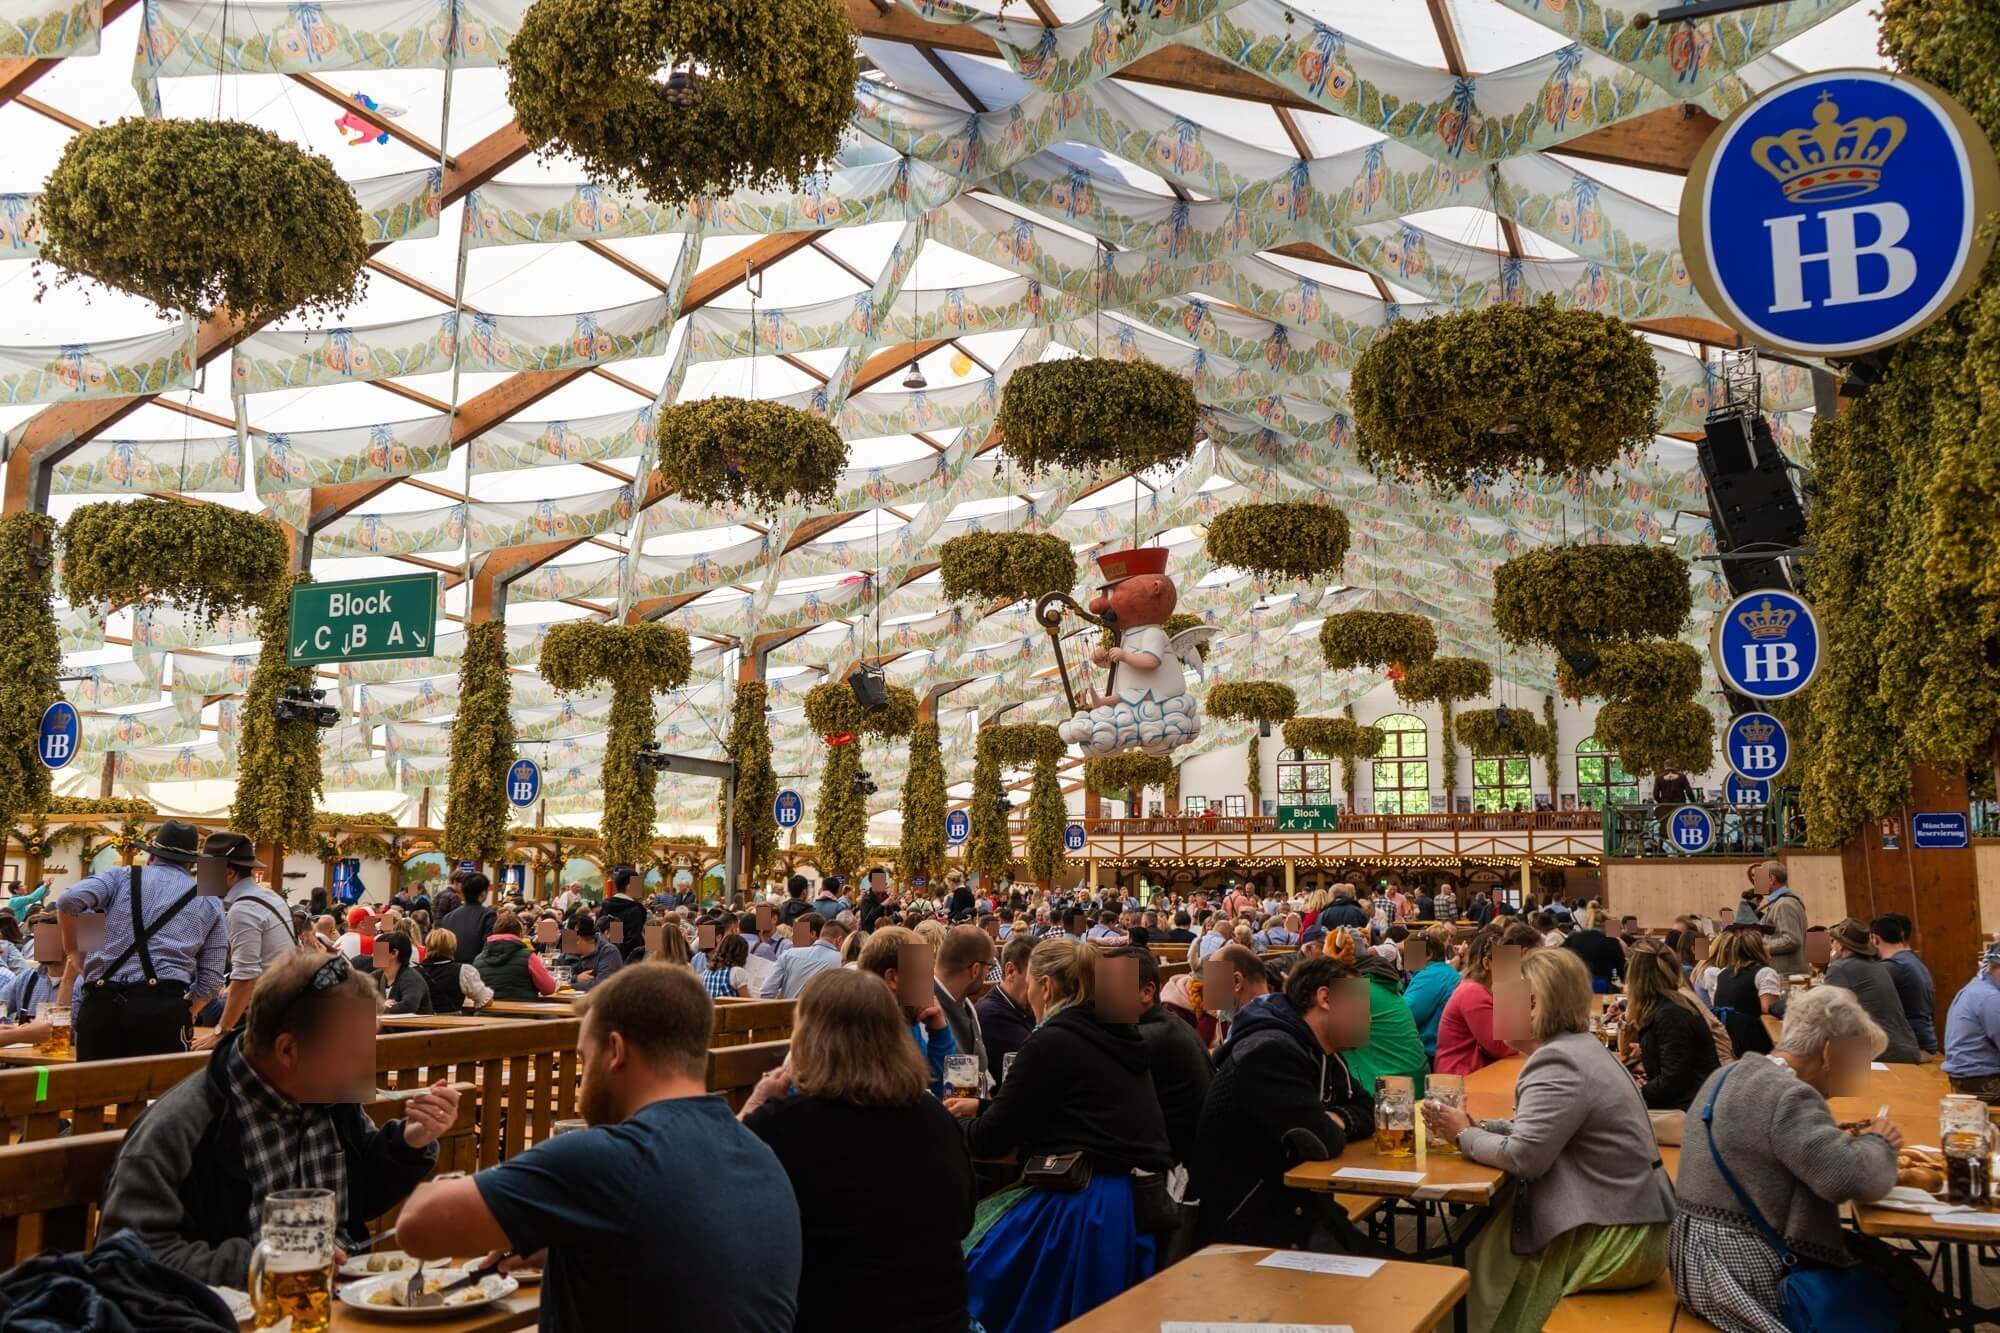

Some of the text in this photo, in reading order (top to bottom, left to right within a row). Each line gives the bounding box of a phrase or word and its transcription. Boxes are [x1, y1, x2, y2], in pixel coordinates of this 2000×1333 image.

[1763, 201, 1918, 314] HB
[329, 589, 392, 618] Block
[314, 621, 405, 650] C B A
[1742, 642, 1800, 683] HB
[45, 734, 70, 759] HB
[1741, 744, 1777, 770] HB
[512, 782, 533, 800] HB
[1736, 789, 1761, 803] HB
[780, 807, 797, 822] HB
[1293, 808, 1321, 818] Block
[951, 823, 966, 837] HB
[1287, 819, 1296, 828] K
[1306, 819, 1312, 828] J
[1069, 836, 1082, 847] HB
[1680, 828, 1703, 845] HB
